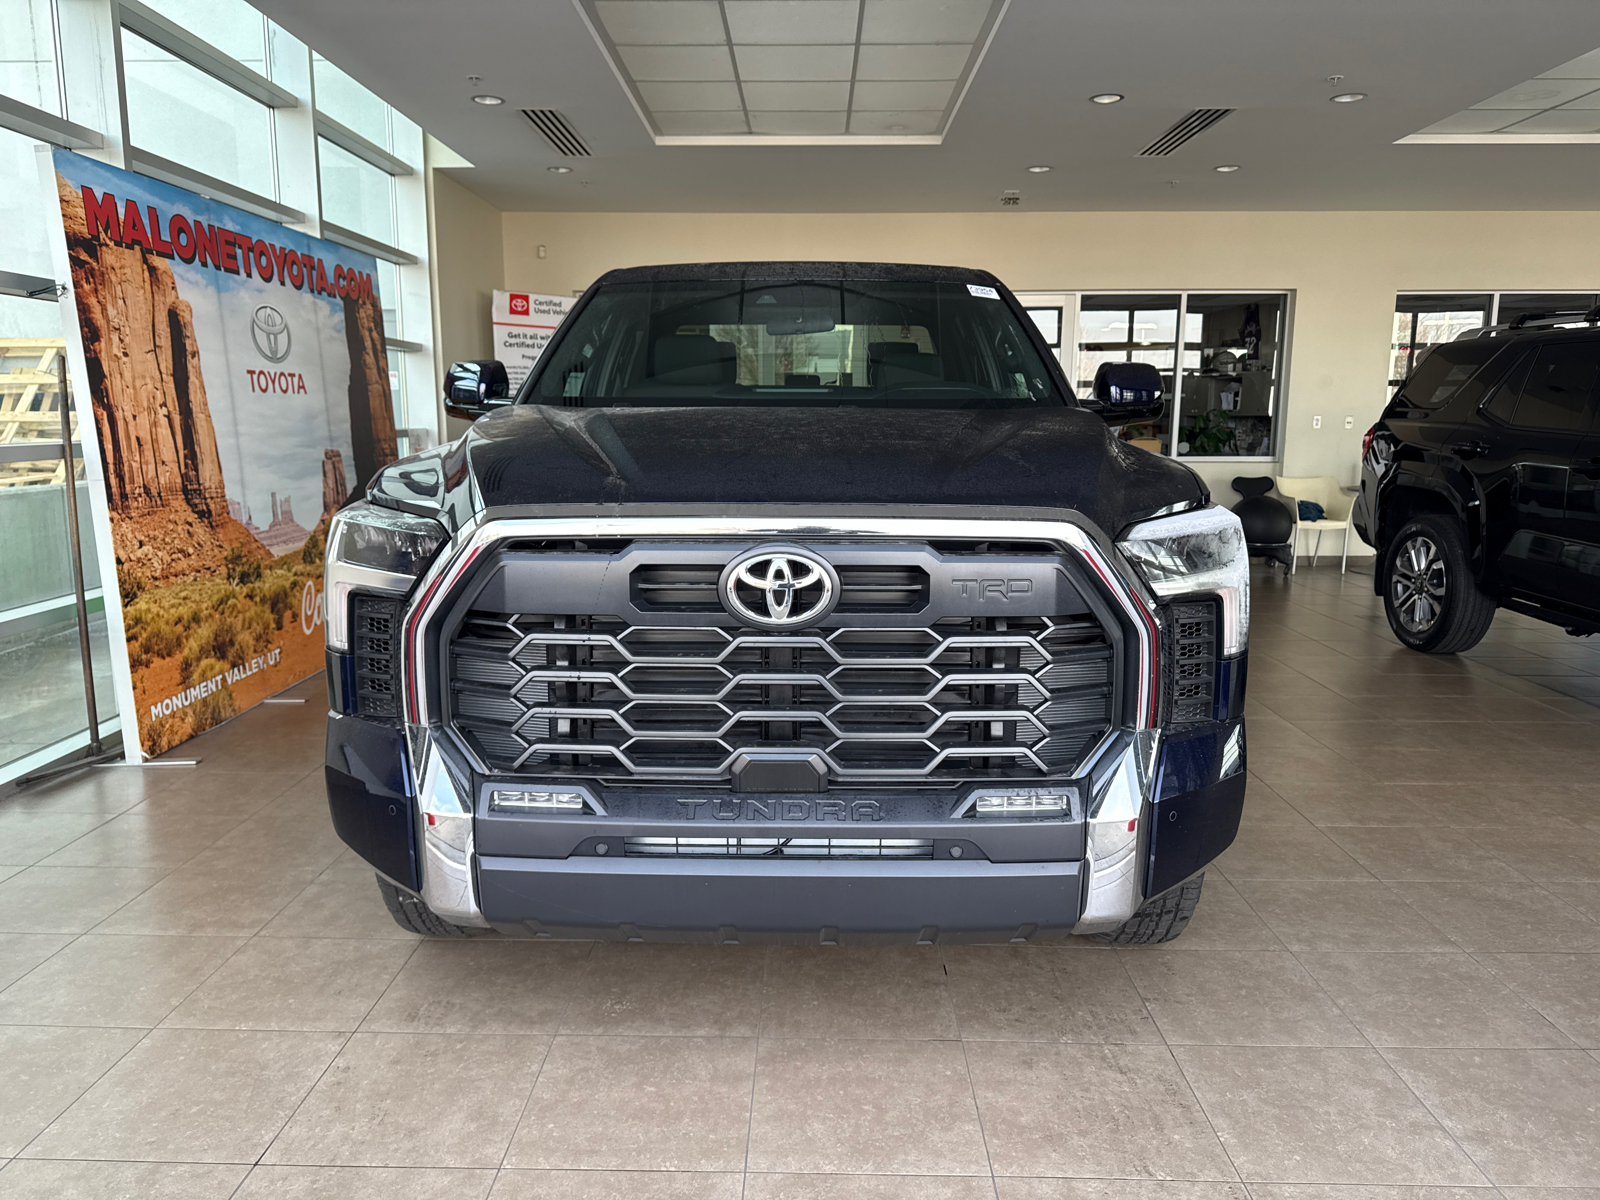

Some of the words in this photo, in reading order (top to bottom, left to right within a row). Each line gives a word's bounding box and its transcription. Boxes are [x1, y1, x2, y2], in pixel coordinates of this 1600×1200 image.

[81, 185, 374, 302] MALONETOYOTA.COM
[533, 299, 562, 308] Certified
[533, 307, 551, 315] Used
[503, 341, 535, 349] Certified
[529, 332, 538, 340] all
[246, 369, 307, 395] TOYOTA
[952, 579, 1033, 601] TRD
[149, 674, 223, 721] MONUMENT
[224, 655, 267, 686] VALLEY,
[267, 648, 281, 666] UT
[676, 799, 883, 821] TUNDRA
